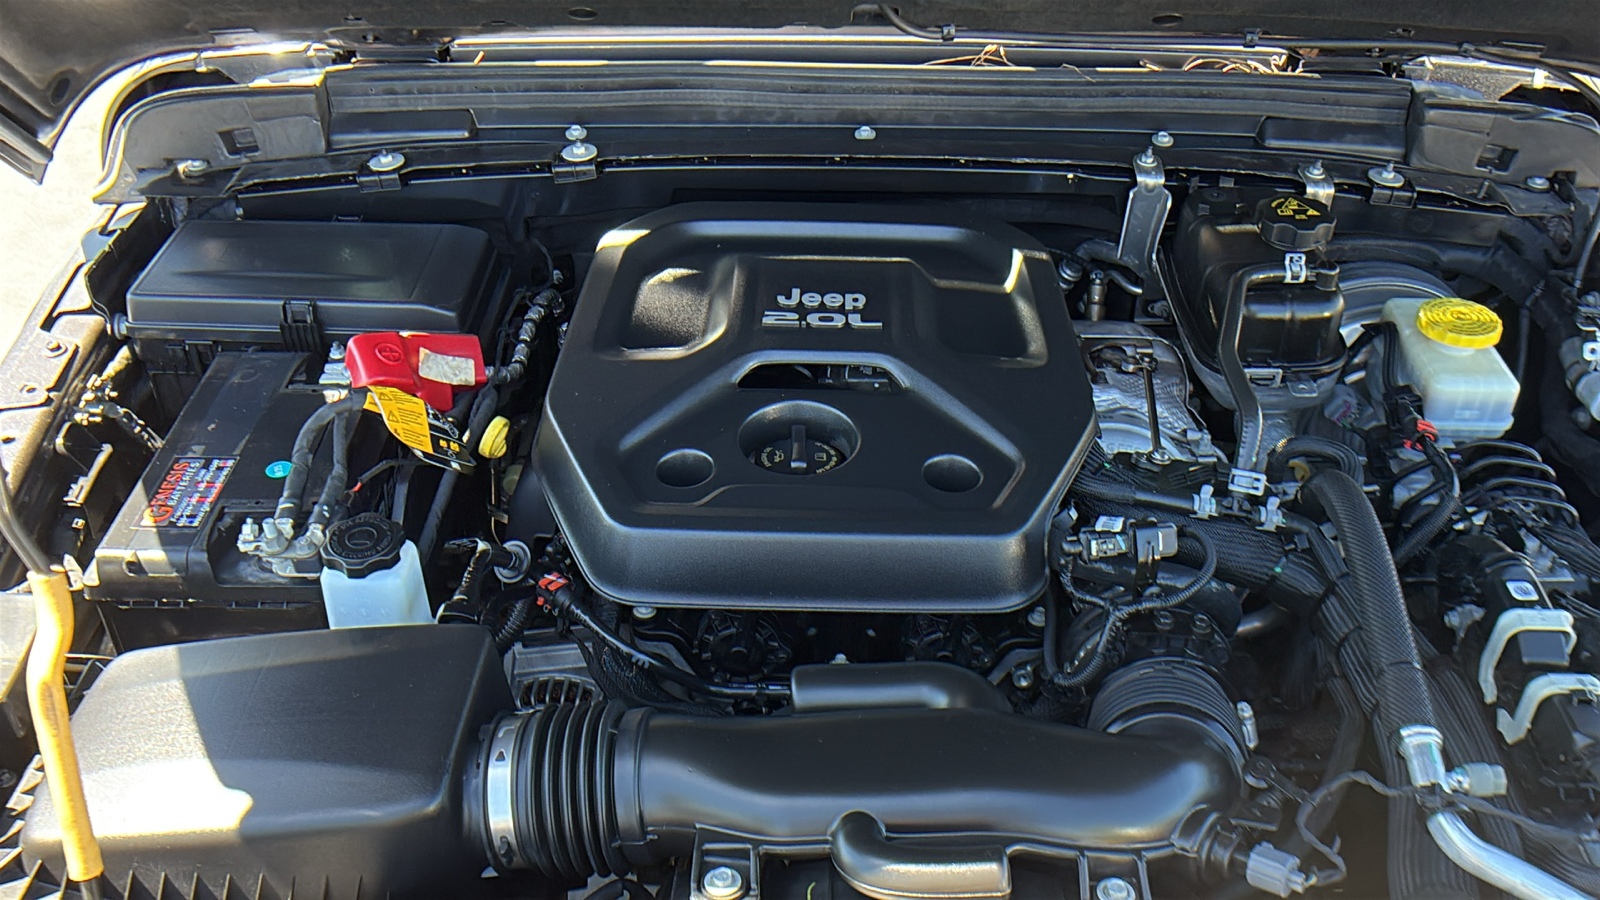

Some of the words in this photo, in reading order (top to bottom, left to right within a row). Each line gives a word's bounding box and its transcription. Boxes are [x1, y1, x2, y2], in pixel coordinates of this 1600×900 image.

[777, 288, 866, 310] Jeep
[762, 311, 883, 329] 2.0L
[143, 462, 190, 523] GENESIS
[166, 461, 200, 506] BATTERIES
